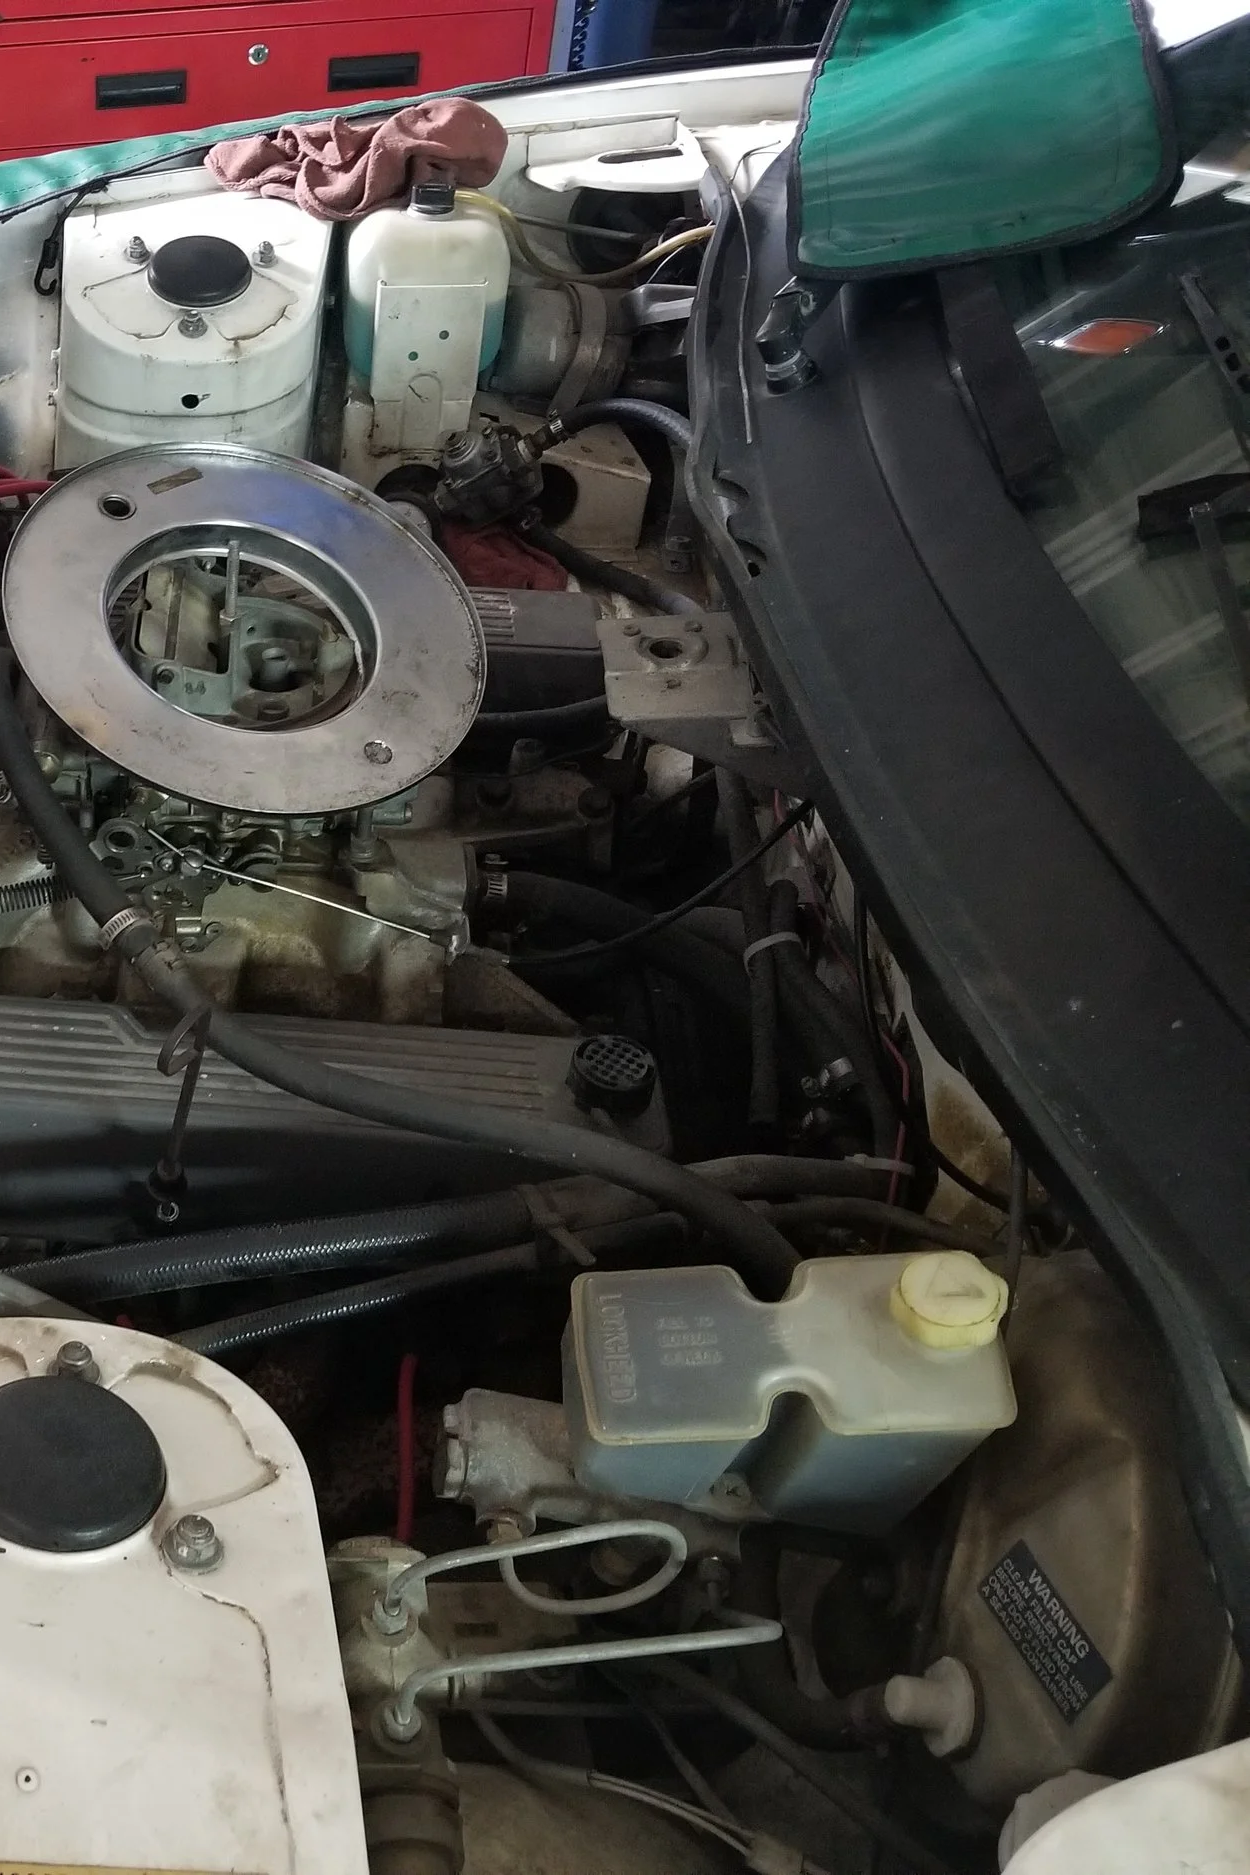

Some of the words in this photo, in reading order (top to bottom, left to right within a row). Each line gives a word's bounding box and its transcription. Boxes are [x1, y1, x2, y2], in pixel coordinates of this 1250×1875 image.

[981, 1584, 991, 1597] A
[990, 1595, 1022, 1641] SEALED
[988, 1575, 1011, 1604] ONLY
[1008, 1604, 1027, 1629] DOT
[1032, 1639, 1056, 1675] FLUID
[1055, 1674, 1082, 1712] FROM
[995, 1566, 1027, 1612] BEFORE
[1069, 1675, 1089, 1701] USE
[1003, 1558, 1032, 1599] CLEAN
[1030, 1598, 1058, 1640] FILLER
[1056, 1639, 1078, 1664] CAP
[1028, 1568, 1090, 1660] WARNING
